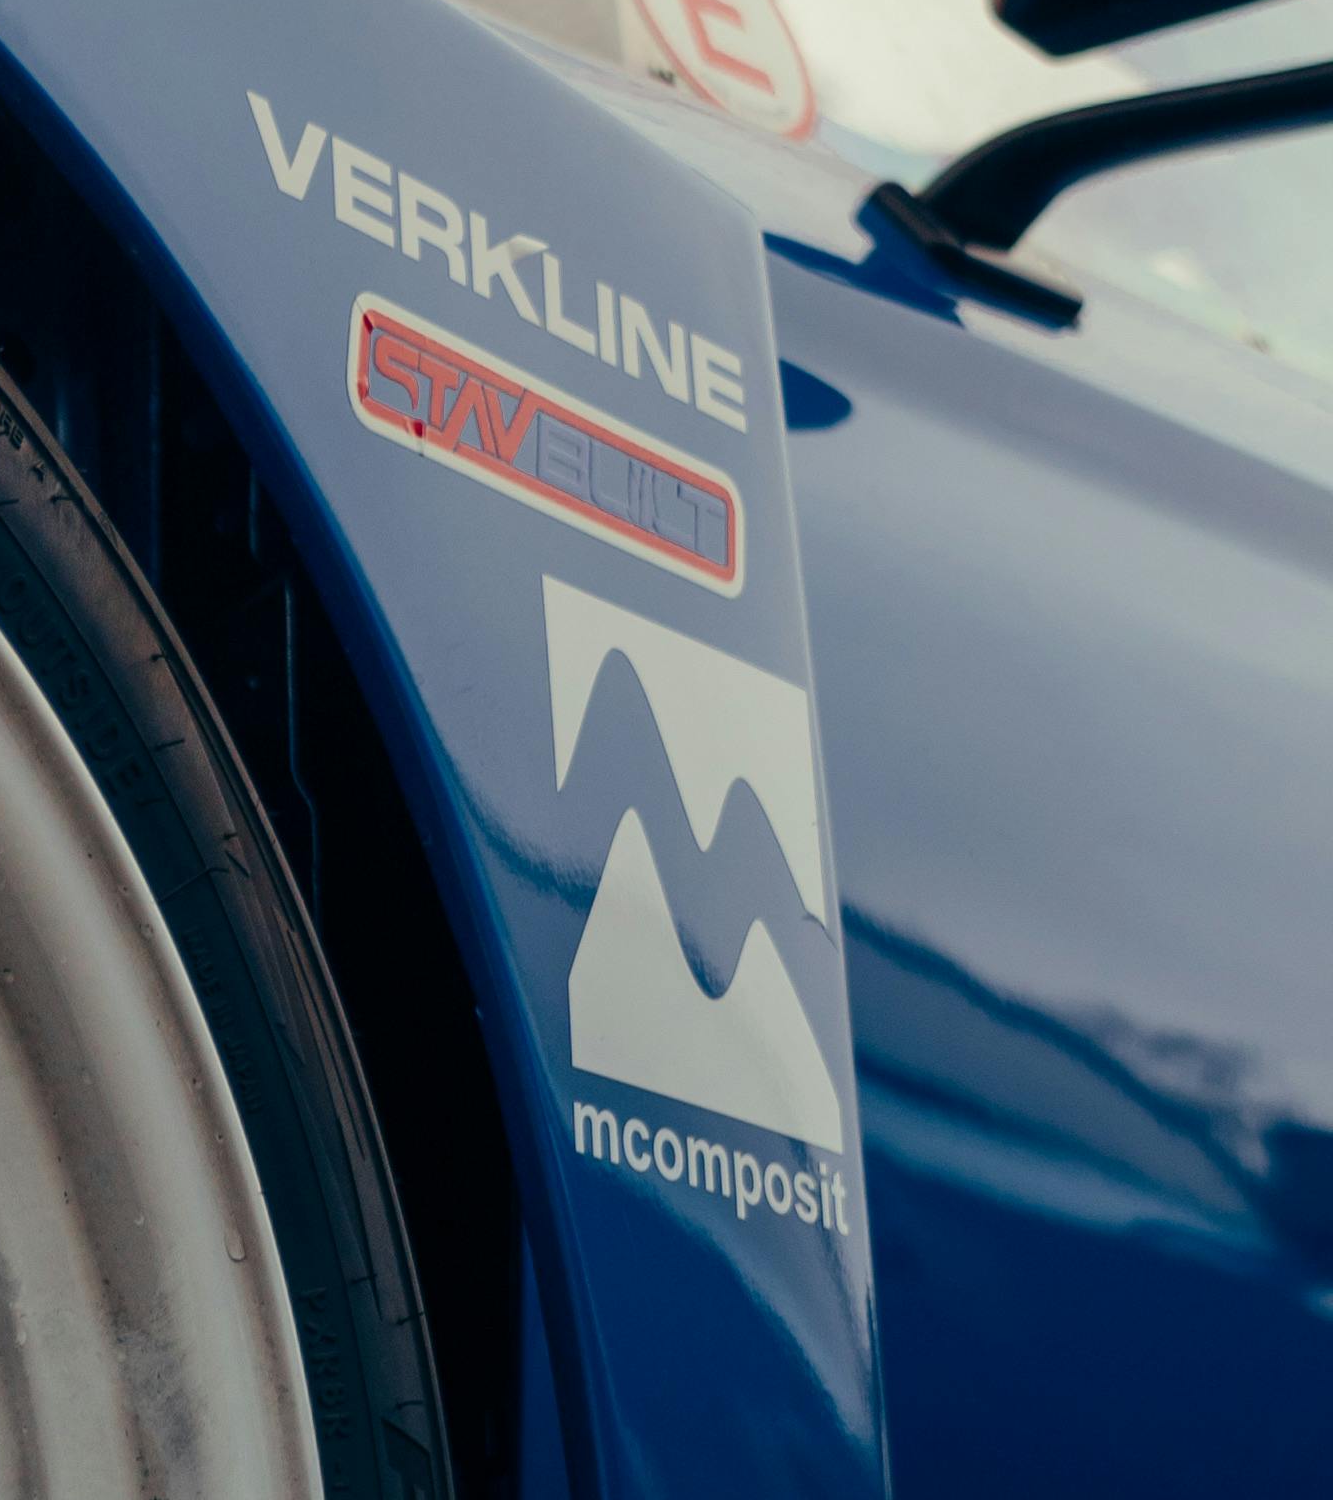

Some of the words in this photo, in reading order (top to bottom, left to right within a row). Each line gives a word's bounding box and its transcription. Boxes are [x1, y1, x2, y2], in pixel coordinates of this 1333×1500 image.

[246, 90, 749, 434] VERKLINE
[182, 921, 223, 998] MADE
[223, 1031, 265, 1118] JAPAN
[573, 1100, 849, 1236] mcomposit
